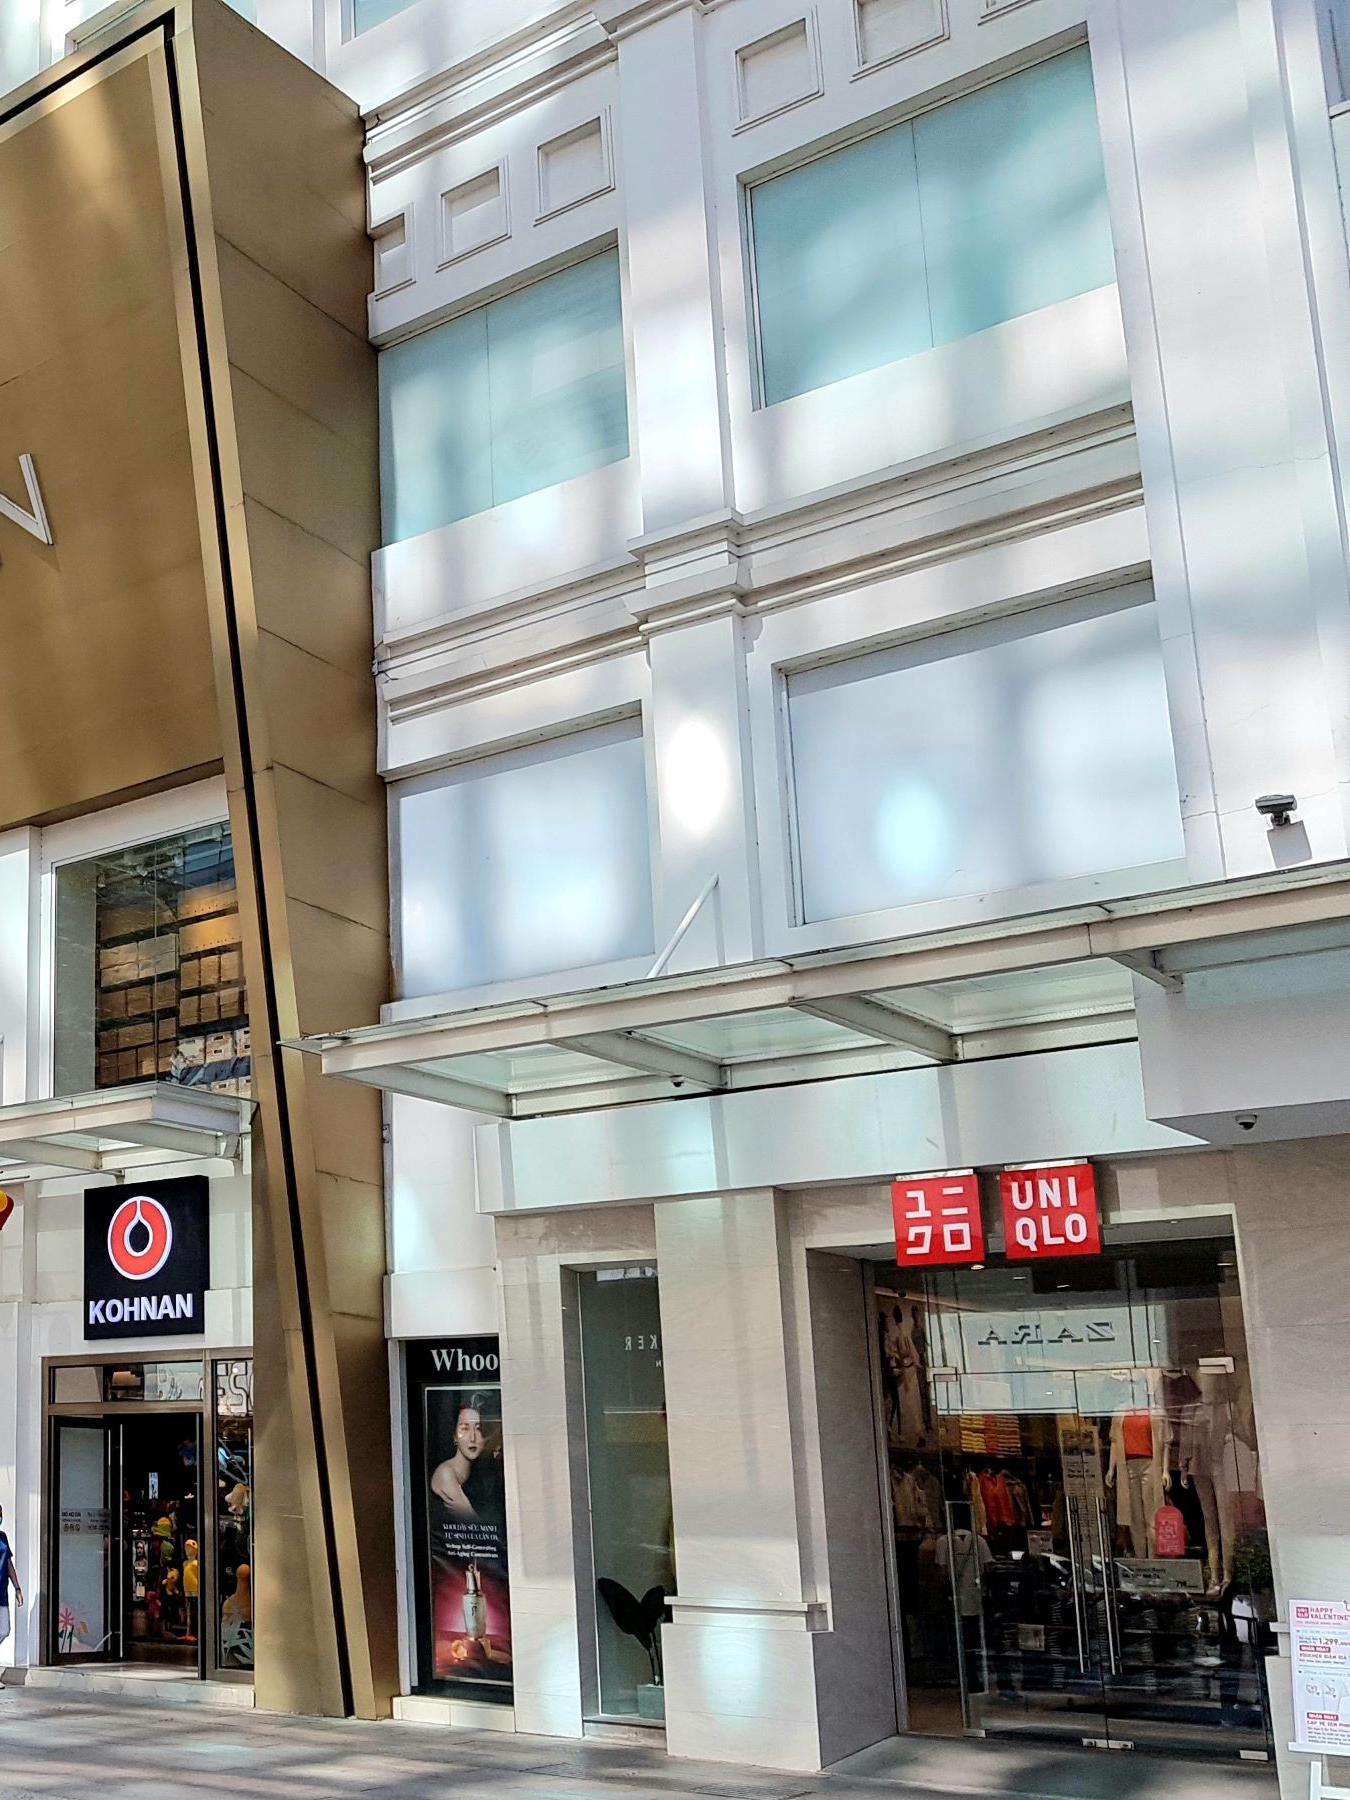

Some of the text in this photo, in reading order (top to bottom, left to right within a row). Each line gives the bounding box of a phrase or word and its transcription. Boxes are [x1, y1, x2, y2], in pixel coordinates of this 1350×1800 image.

[1011, 1176, 1078, 1210] UNI
[1015, 1213, 1088, 1252] QLO
[89, 1293, 194, 1325] KOHNAN
[430, 1348, 499, 1372] Whoo
